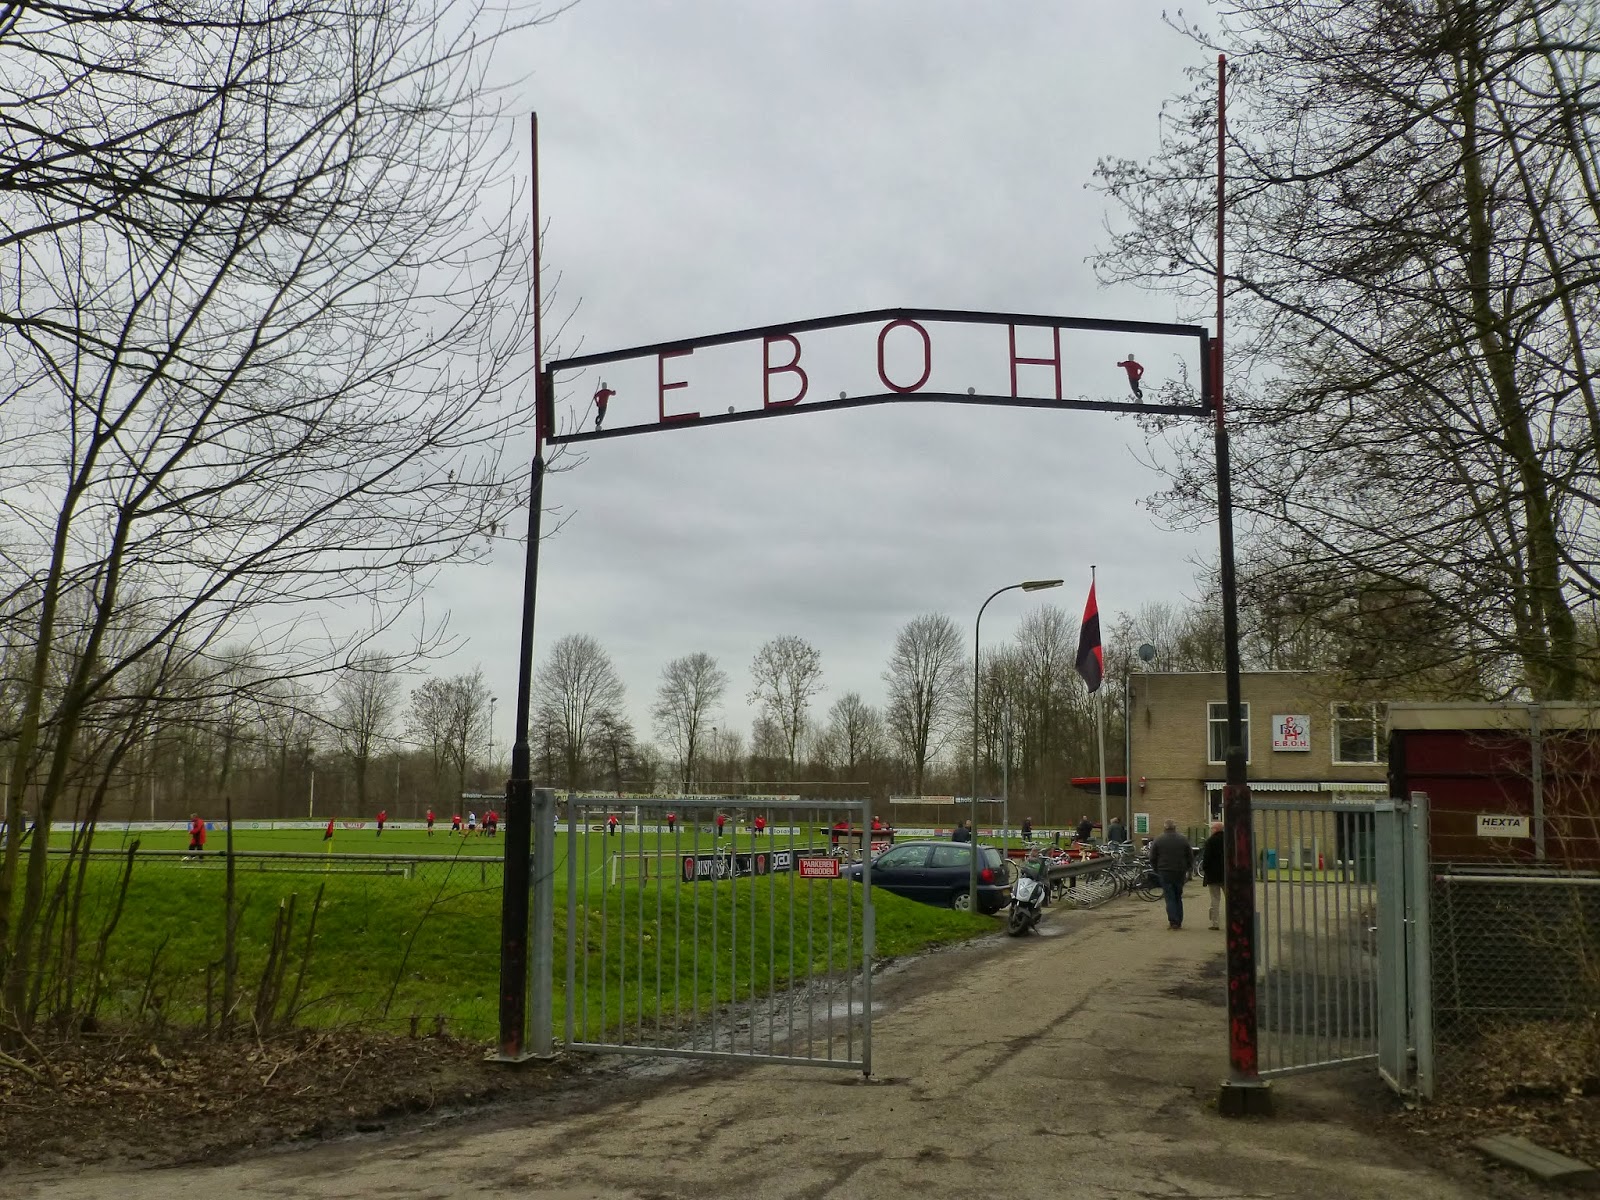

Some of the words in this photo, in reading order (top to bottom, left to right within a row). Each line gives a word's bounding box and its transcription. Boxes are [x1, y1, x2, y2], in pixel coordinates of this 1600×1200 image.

[1482, 818, 1521, 827] HEXTA
[803, 860, 834, 868] PARKEREN
[803, 867, 835, 875] VERBODEN
